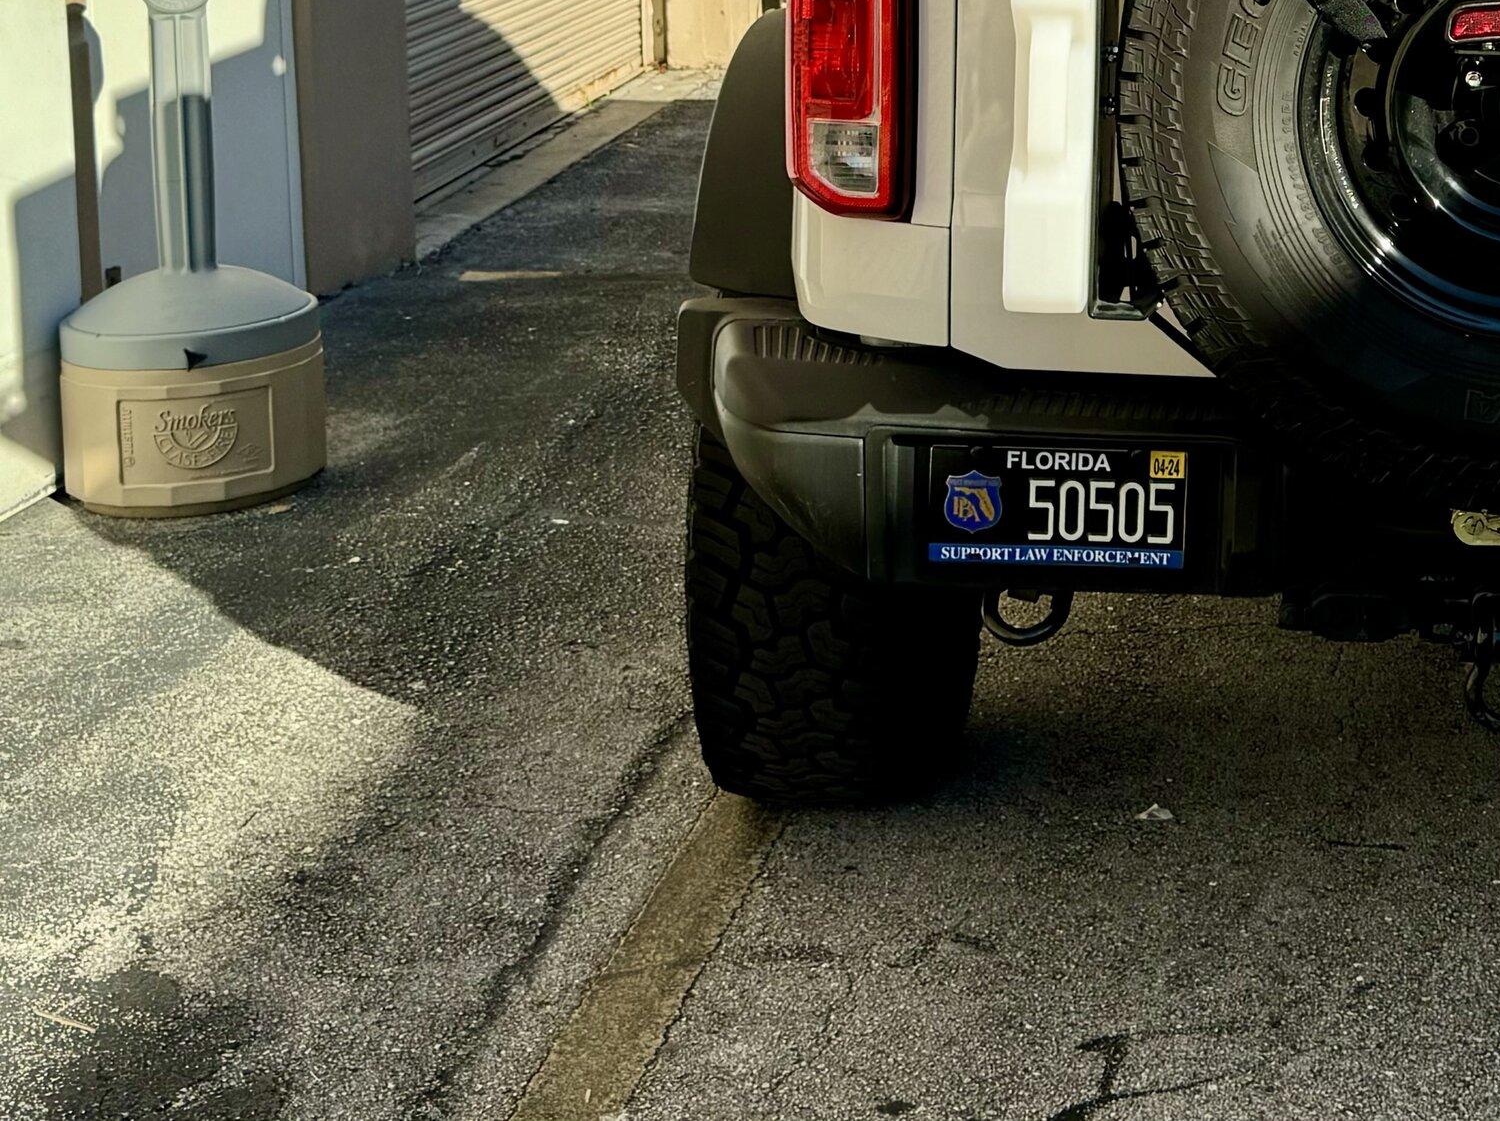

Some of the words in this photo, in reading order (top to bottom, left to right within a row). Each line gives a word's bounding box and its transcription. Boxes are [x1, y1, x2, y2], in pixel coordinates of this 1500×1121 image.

[155, 404, 237, 433] Smokers
[1006, 451, 1111, 473] FLORIDA
[1153, 457, 1181, 476] 04-24
[1027, 479, 1176, 545] 50505
[1015, 548, 1049, 562] LAW
